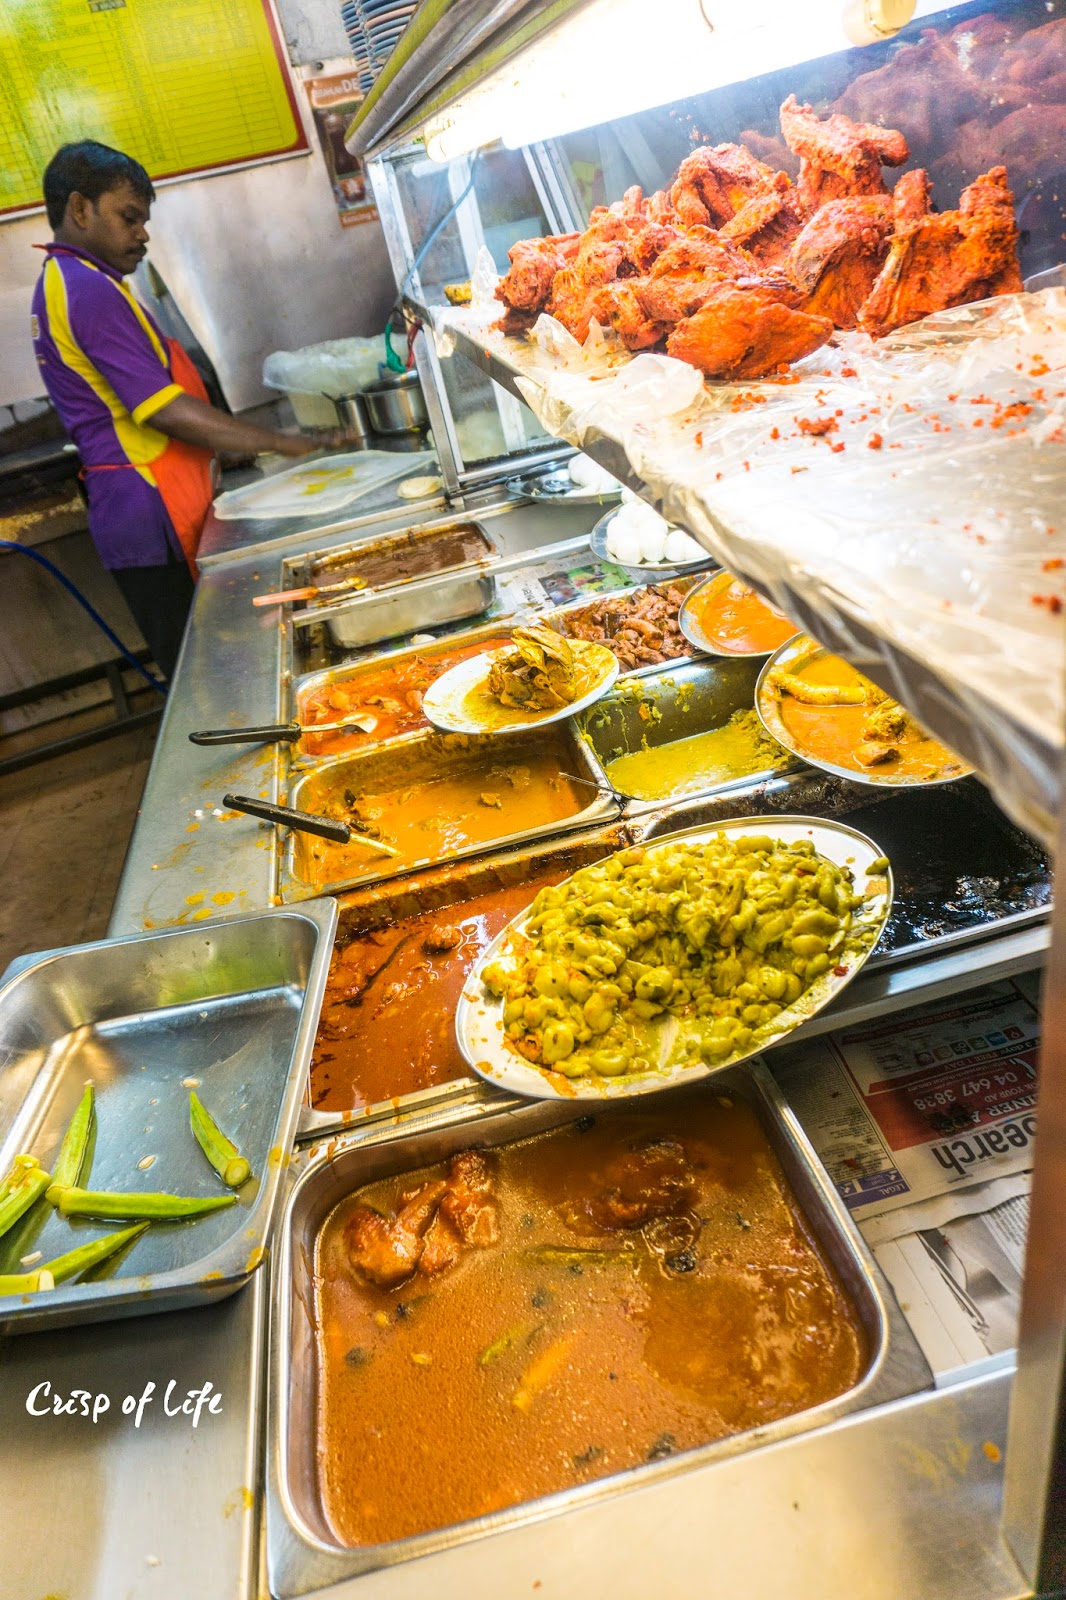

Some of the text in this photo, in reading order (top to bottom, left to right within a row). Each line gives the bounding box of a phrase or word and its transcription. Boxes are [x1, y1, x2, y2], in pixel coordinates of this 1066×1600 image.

[992, 1070, 1018, 1086] 04
[961, 1077, 991, 1096] 647
[998, 1086, 1023, 1097] YOUR
[911, 1087, 956, 1110] 3838
[983, 1093, 996, 1102] AD
[878, 1182, 905, 1194] LEGAL
